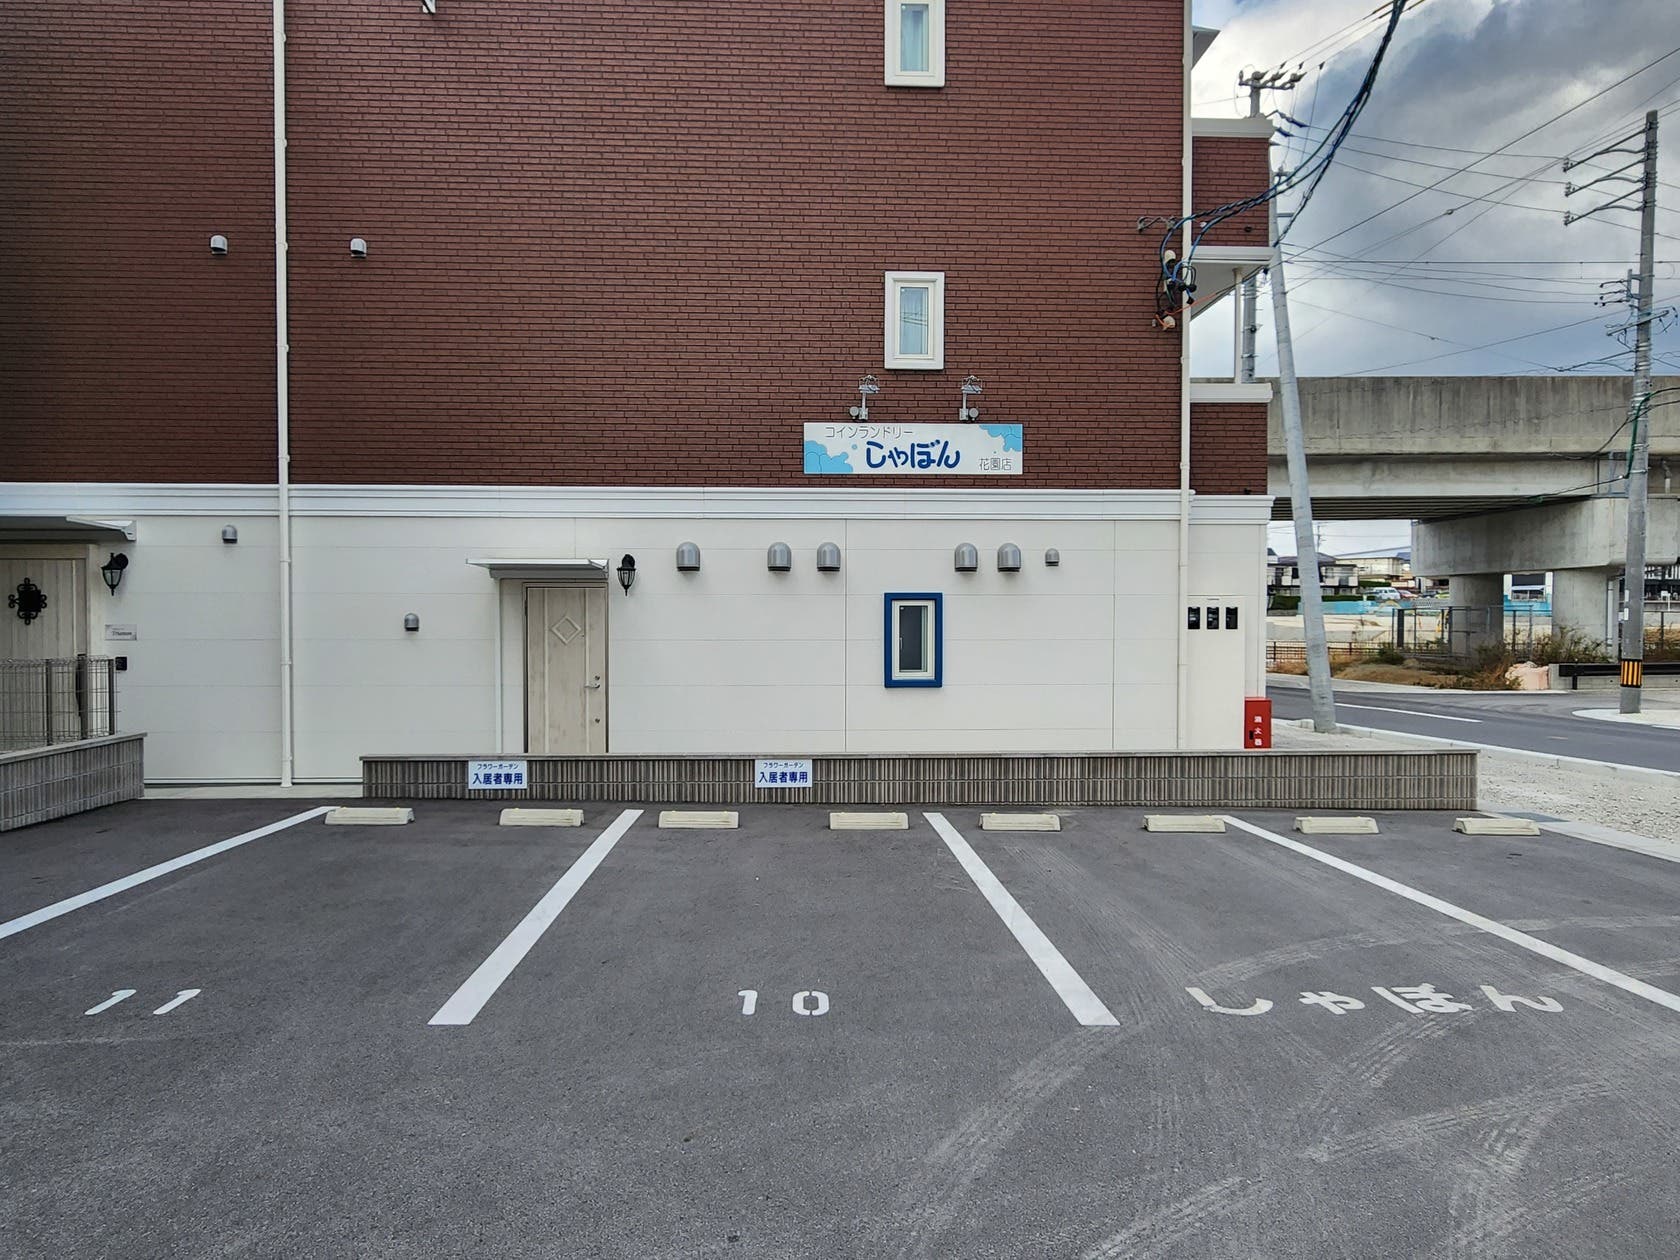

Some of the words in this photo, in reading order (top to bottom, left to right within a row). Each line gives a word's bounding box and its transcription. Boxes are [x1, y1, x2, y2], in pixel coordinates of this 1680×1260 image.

[825, 425, 913, 439] コインランドリー
[866, 439, 961, 469] しゃぼん
[979, 457, 1012, 471] 花園店
[472, 772, 523, 785] 入居者専用
[758, 771, 808, 784] 入居者専用
[738, 989, 830, 1016] 10
